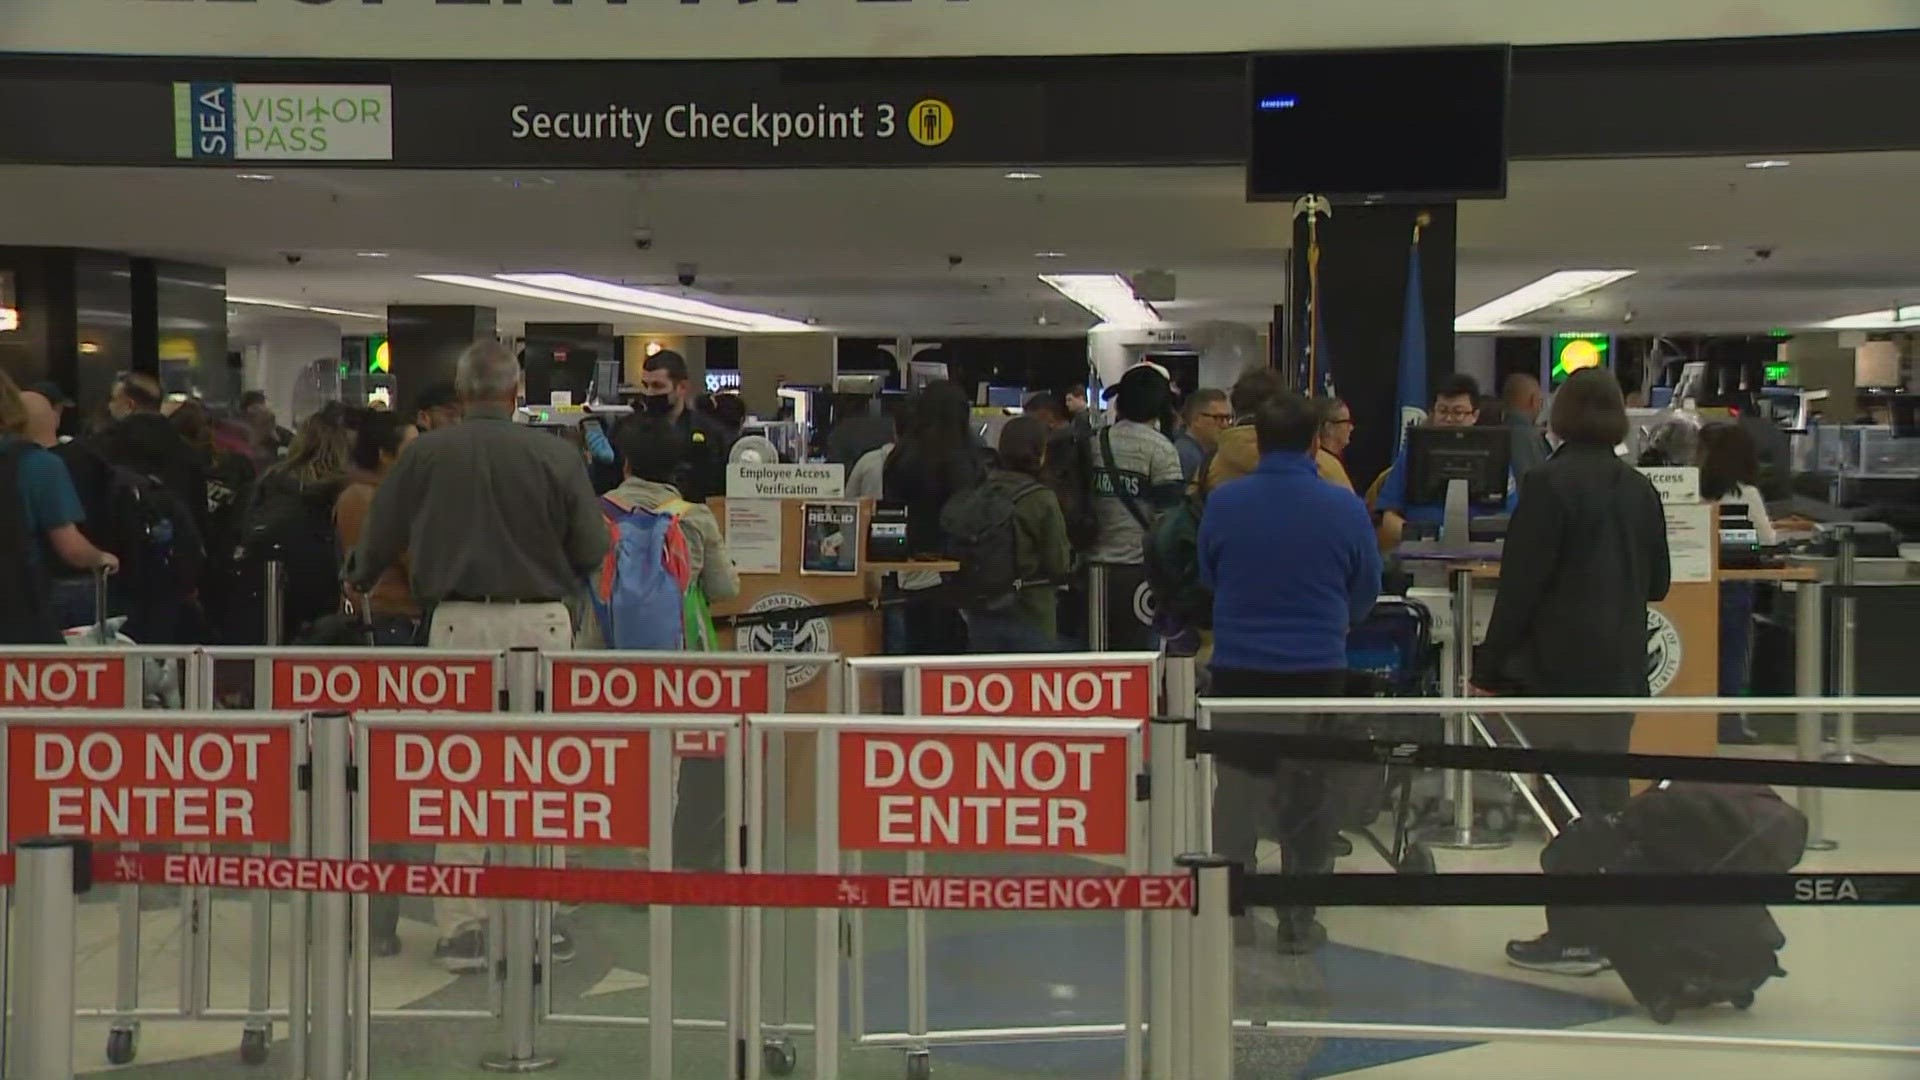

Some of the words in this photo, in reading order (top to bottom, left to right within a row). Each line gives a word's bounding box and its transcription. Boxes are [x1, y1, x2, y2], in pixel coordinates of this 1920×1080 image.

[200, 87, 227, 155] SEA
[245, 126, 328, 152] PASS
[511, 105, 652, 148] Security
[664, 103, 864, 147] Checkpoint
[876, 105, 896, 138] 3
[739, 467, 791, 481] Employee
[794, 468, 831, 479] Access
[755, 483, 818, 495] Verification
[4, 663, 107, 702] NOT
[292, 665, 361, 704] DO
[377, 665, 476, 704] NOT
[570, 667, 638, 707] DO
[653, 668, 751, 708] NOT
[942, 673, 1014, 713] DO
[1031, 671, 1132, 712] NOT
[34, 732, 123, 782] DO
[145, 733, 271, 782] NOT
[395, 734, 482, 783] DO
[504, 736, 629, 786] NOT
[864, 739, 954, 789] DO
[976, 741, 1105, 791] NOT
[48, 787, 255, 836] ENTER
[409, 789, 612, 839] ENTER
[878, 795, 1087, 846] ENTER
[164, 855, 395, 892] EMERGENCY
[405, 866, 485, 896] EXIT
[887, 878, 1126, 910] EMERGENCY
[1794, 878, 1859, 901] SEA
